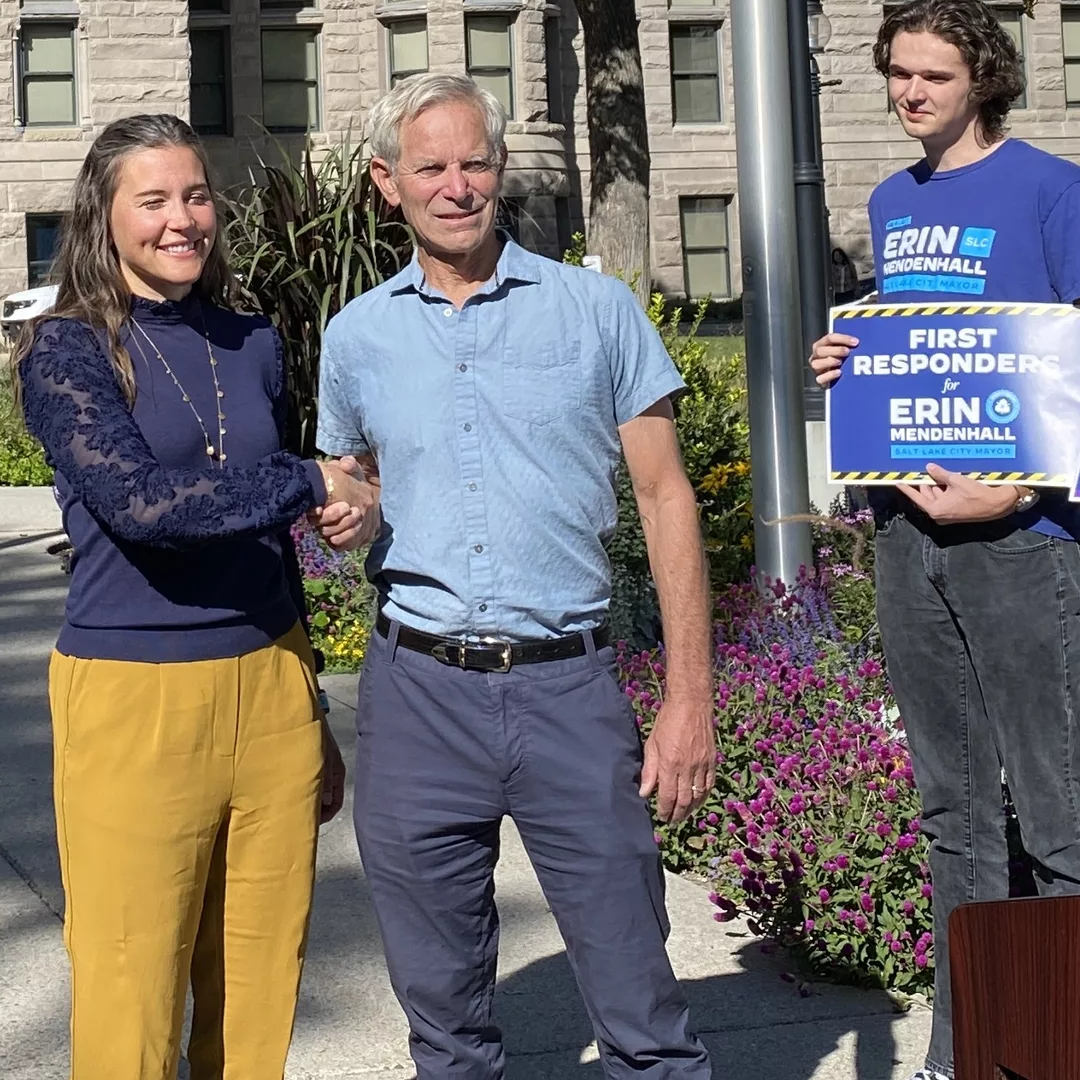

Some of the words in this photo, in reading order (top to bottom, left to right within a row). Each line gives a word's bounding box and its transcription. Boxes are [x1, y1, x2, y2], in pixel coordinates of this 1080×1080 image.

[883, 225, 960, 259] ERIN
[965, 236, 989, 248] SLC
[915, 278, 933, 287] CIT
[940, 280, 980, 290] MAYOR
[909, 328, 997, 349] FIRST
[853, 352, 1060, 376] RESPONDERS
[941, 377, 960, 394] for
[890, 397, 980, 425] ERIN
[890, 427, 1016, 441] MENDENHALL
[895, 448, 919, 456] SALT
[922, 448, 946, 456] LAKE
[950, 448, 972, 456] CITY
[976, 447, 1011, 455] MAYOR
